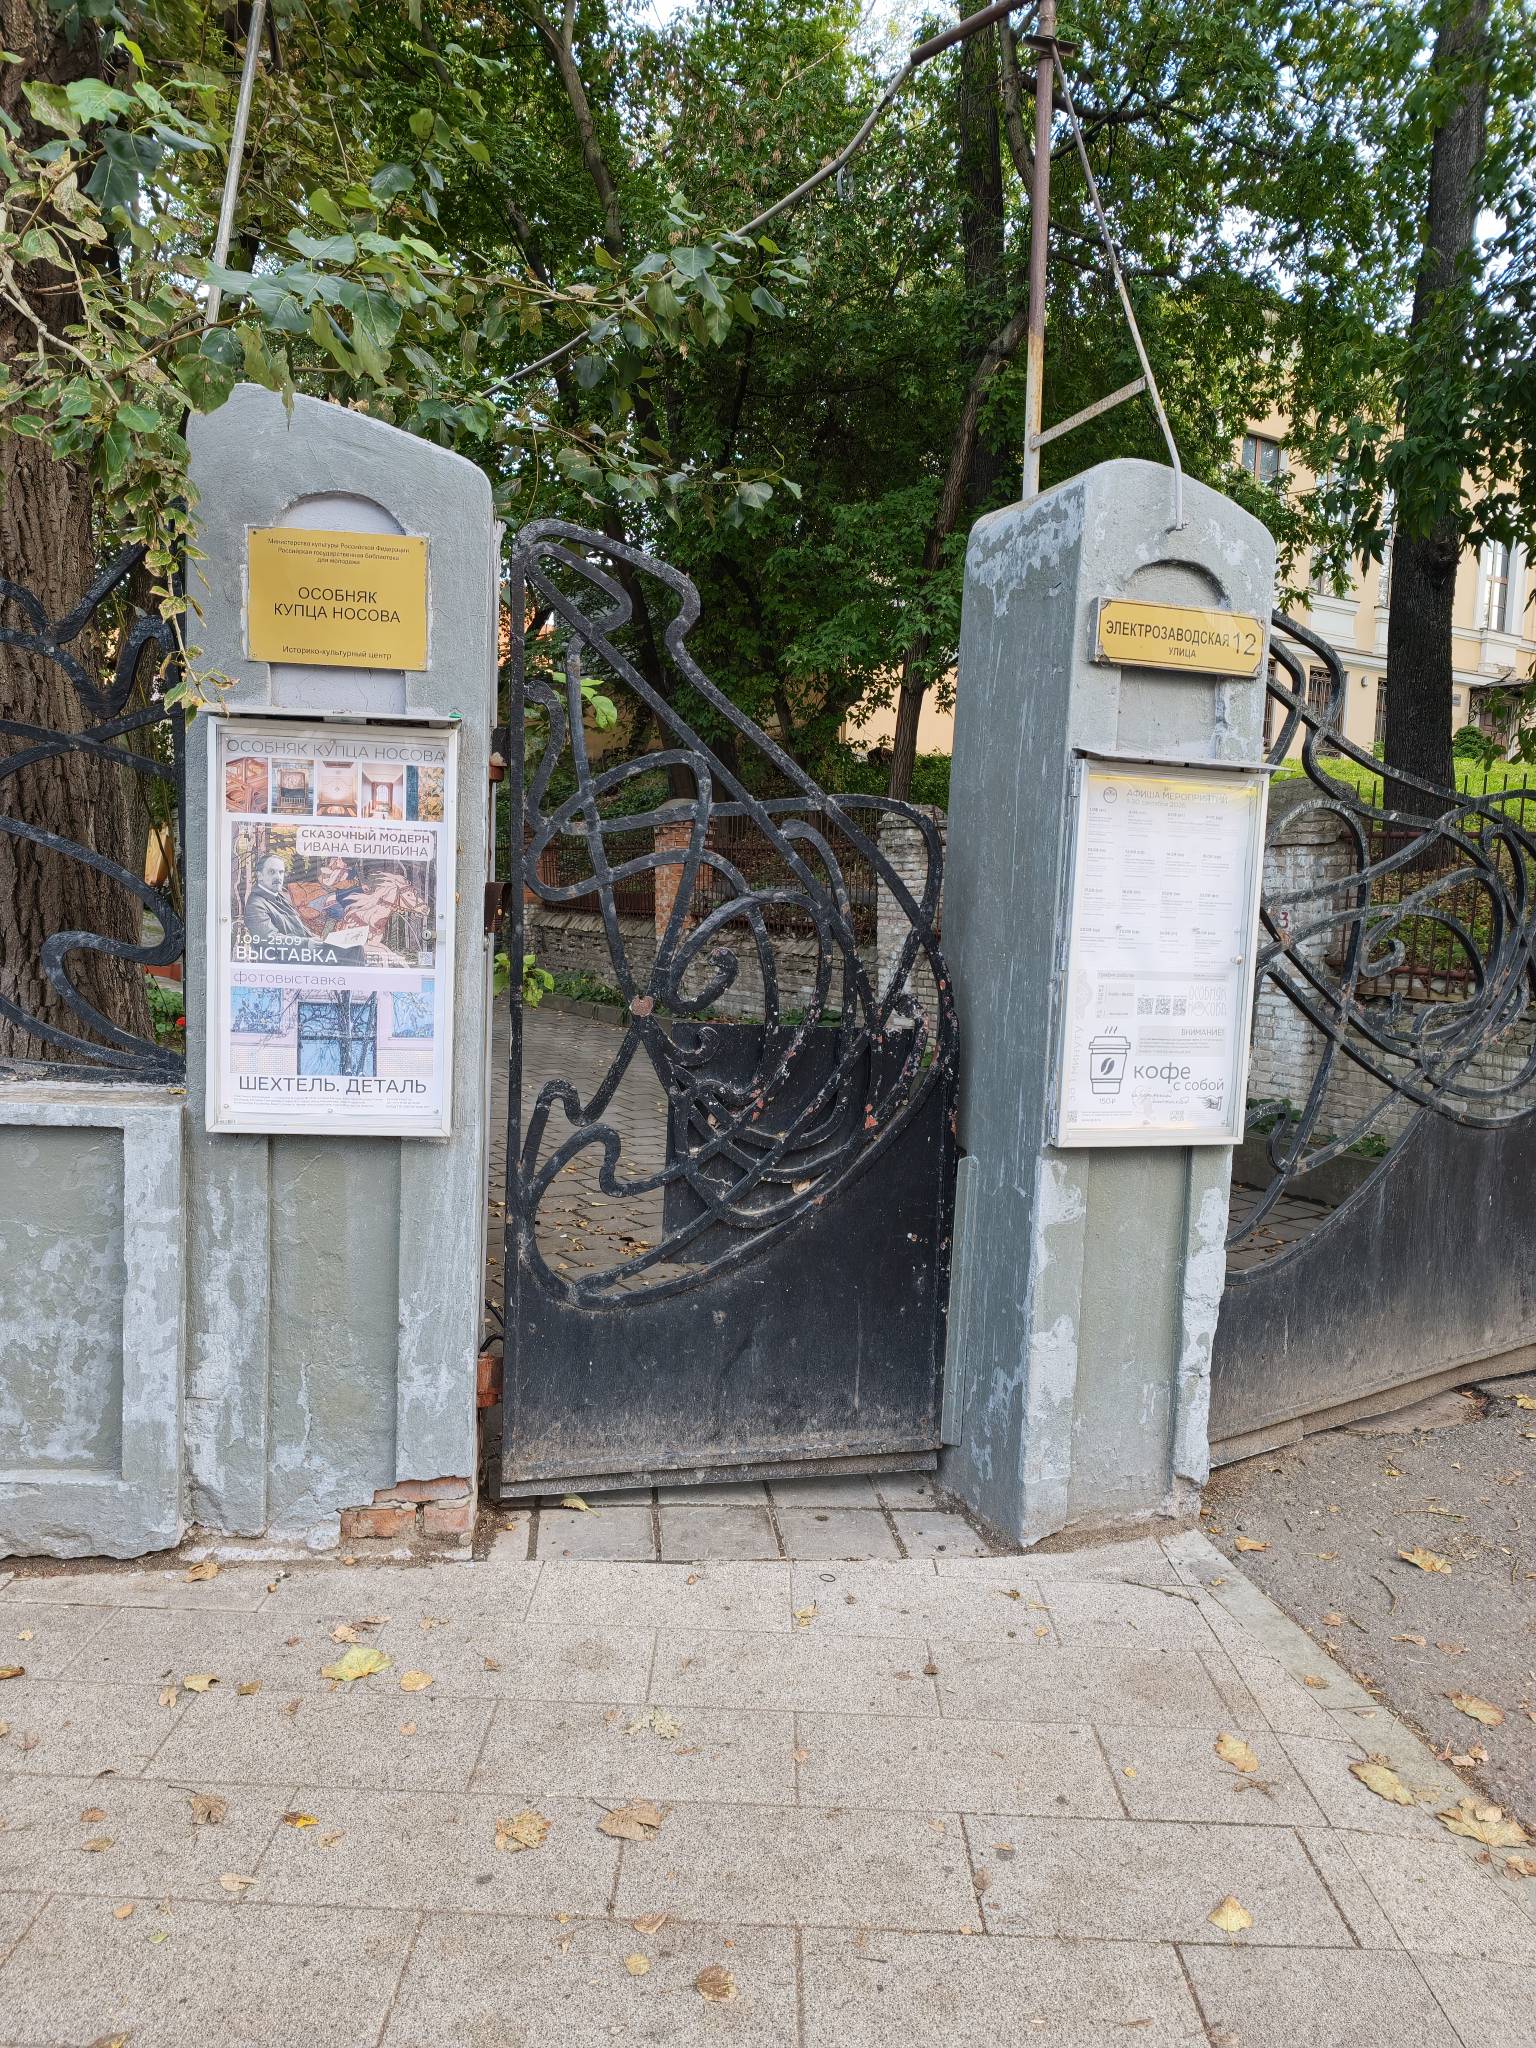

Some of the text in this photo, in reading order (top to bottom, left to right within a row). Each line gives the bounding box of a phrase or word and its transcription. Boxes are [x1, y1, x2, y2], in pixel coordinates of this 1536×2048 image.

[268, 538, 410, 554] Министерство культуры Российской Федерации
[277, 547, 313, 555] Российская
[365, 552, 400, 561] библиотека
[298, 586, 378, 604] ОСОБНЯК
[274, 602, 401, 623] КУПЦА НОСОВА
[1106, 620, 1257, 657] ЭЛЕКТРОЗАВОДСКАЯ 12
[282, 645, 392, 661] Историко-культурный центр
[1168, 646, 1197, 659] УЛИЦА
[226, 738, 447, 763] ОСОБНЯК КУПЦА НОСОВА
[301, 828, 431, 845] СКАЗОЧНЫЙ МОДЕРН
[303, 841, 429, 857] ИВАНА БИЛИБИНА
[235, 945, 338, 964] ВЫСТАВКА
[233, 970, 347, 987] фотовыставка
[1133, 1062, 1191, 1084] кофе
[239, 1075, 427, 1096] ШЕХТЕЛЬ. ДЕТАЛЬ
[1173, 1077, 1224, 1091] с собой
